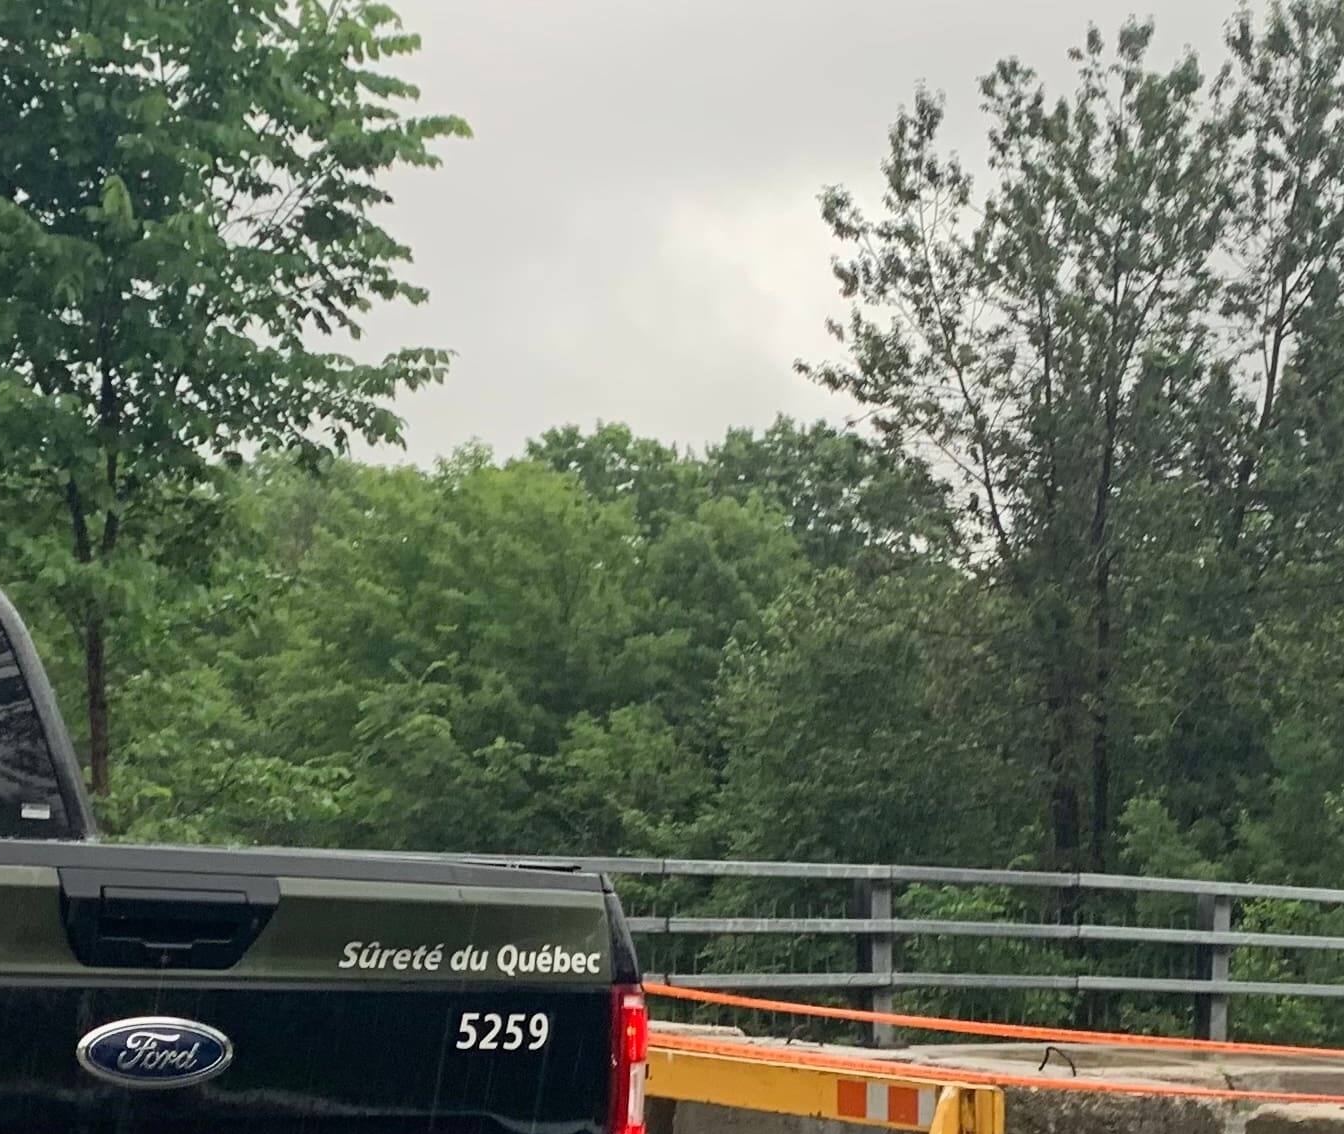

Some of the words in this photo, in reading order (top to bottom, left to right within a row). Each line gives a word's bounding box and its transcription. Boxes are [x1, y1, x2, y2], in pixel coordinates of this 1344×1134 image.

[339, 941, 444, 970] Sûreté
[450, 944, 488, 971] du
[497, 944, 601, 976] Québec
[456, 1012, 549, 1050] 5259
[117, 1031, 200, 1070] Ford
